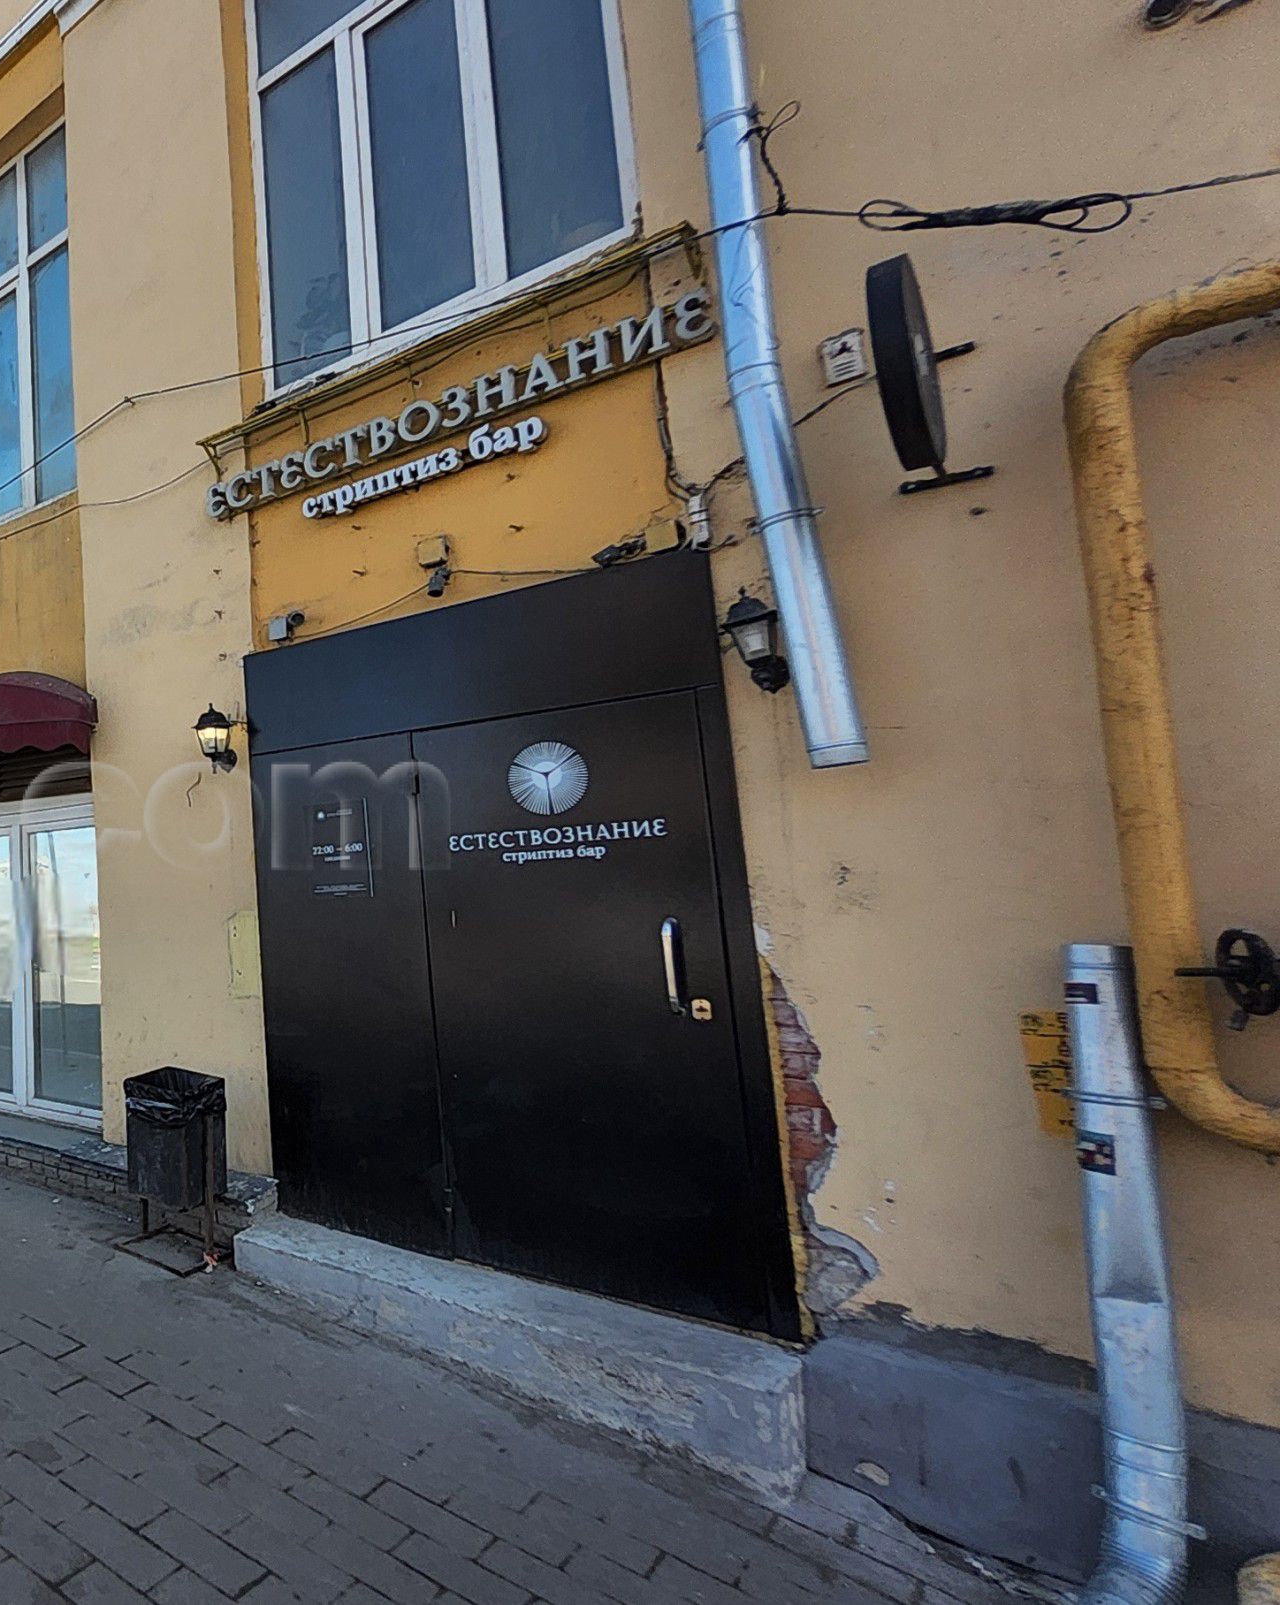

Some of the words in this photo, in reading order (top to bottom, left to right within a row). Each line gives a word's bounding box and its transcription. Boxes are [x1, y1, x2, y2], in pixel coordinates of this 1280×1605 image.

[302, 447, 463, 519] стриптиз
[469, 416, 547, 461] бар
[502, 845, 574, 865] стриптиз
[577, 844, 606, 861] бар
